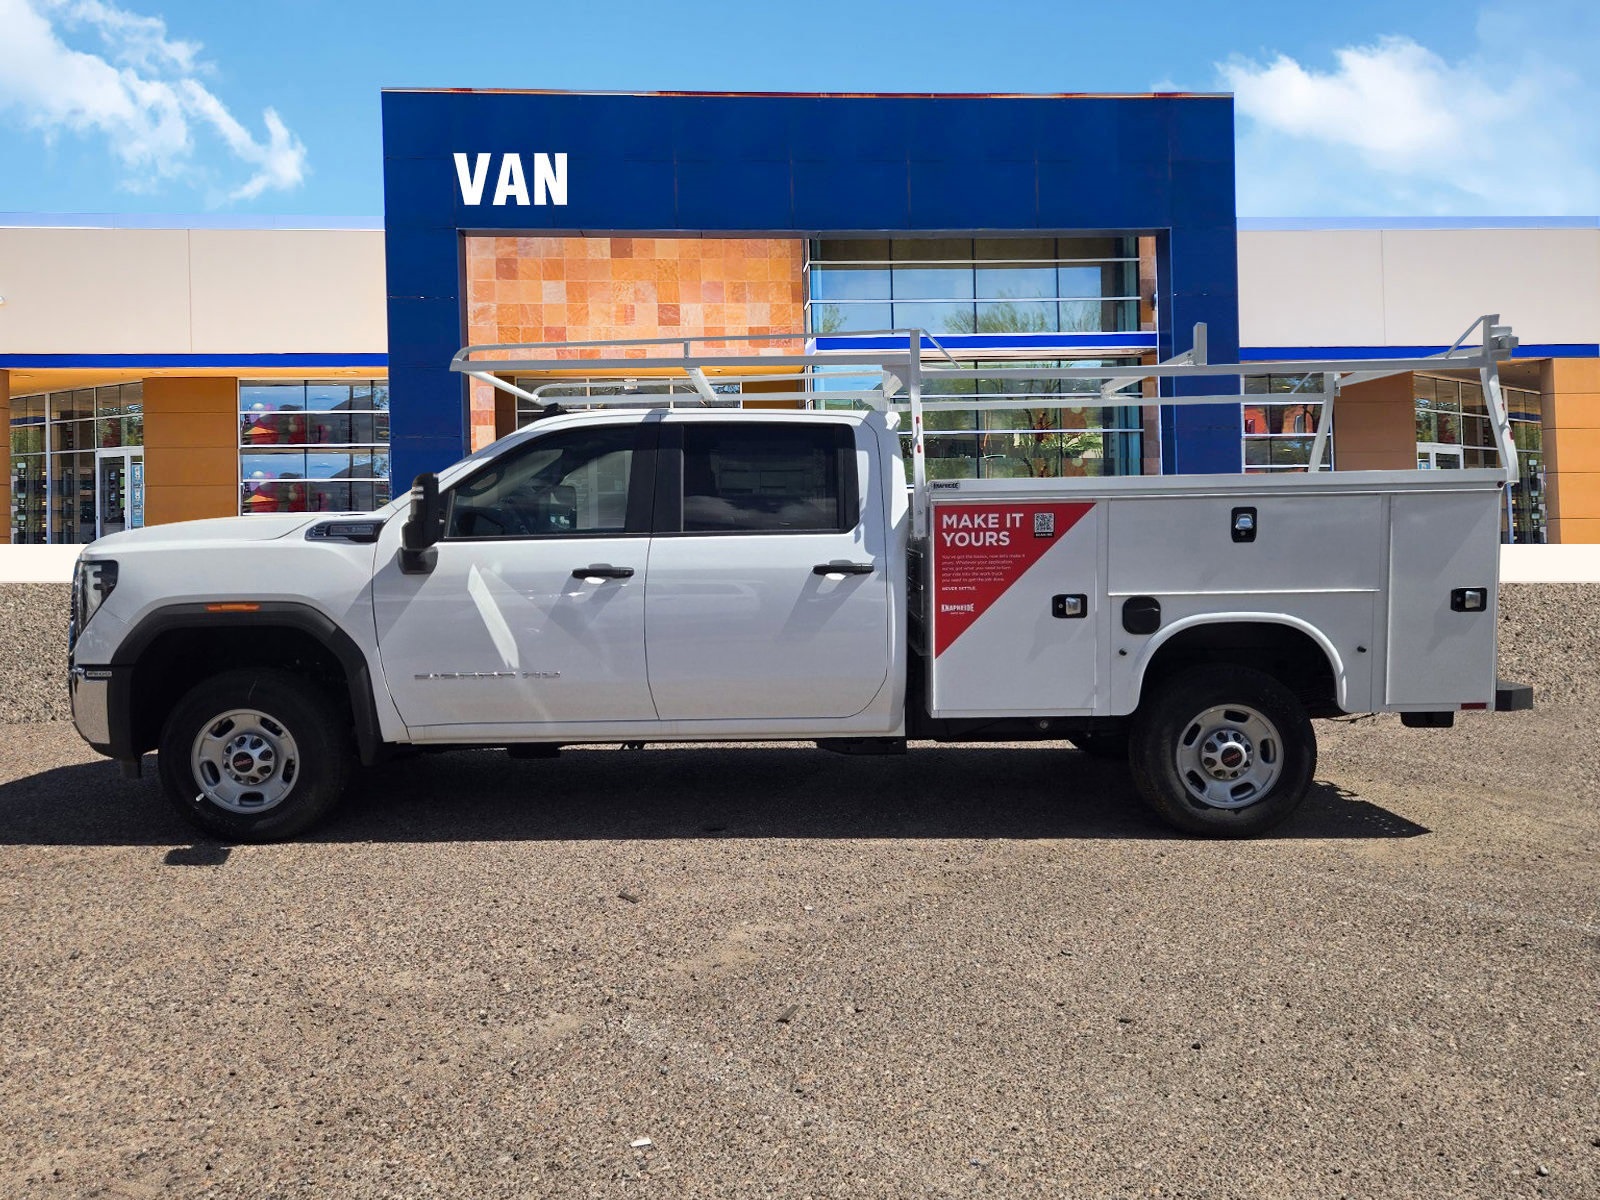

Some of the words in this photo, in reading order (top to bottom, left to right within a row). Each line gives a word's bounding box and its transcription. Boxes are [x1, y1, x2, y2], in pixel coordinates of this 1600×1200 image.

[453, 153, 568, 205] VAN
[942, 513, 1000, 529] MAKE
[1006, 513, 1025, 528] IT
[942, 531, 1010, 547] YOURS
[941, 603, 975, 613] KNAPHEIDE
